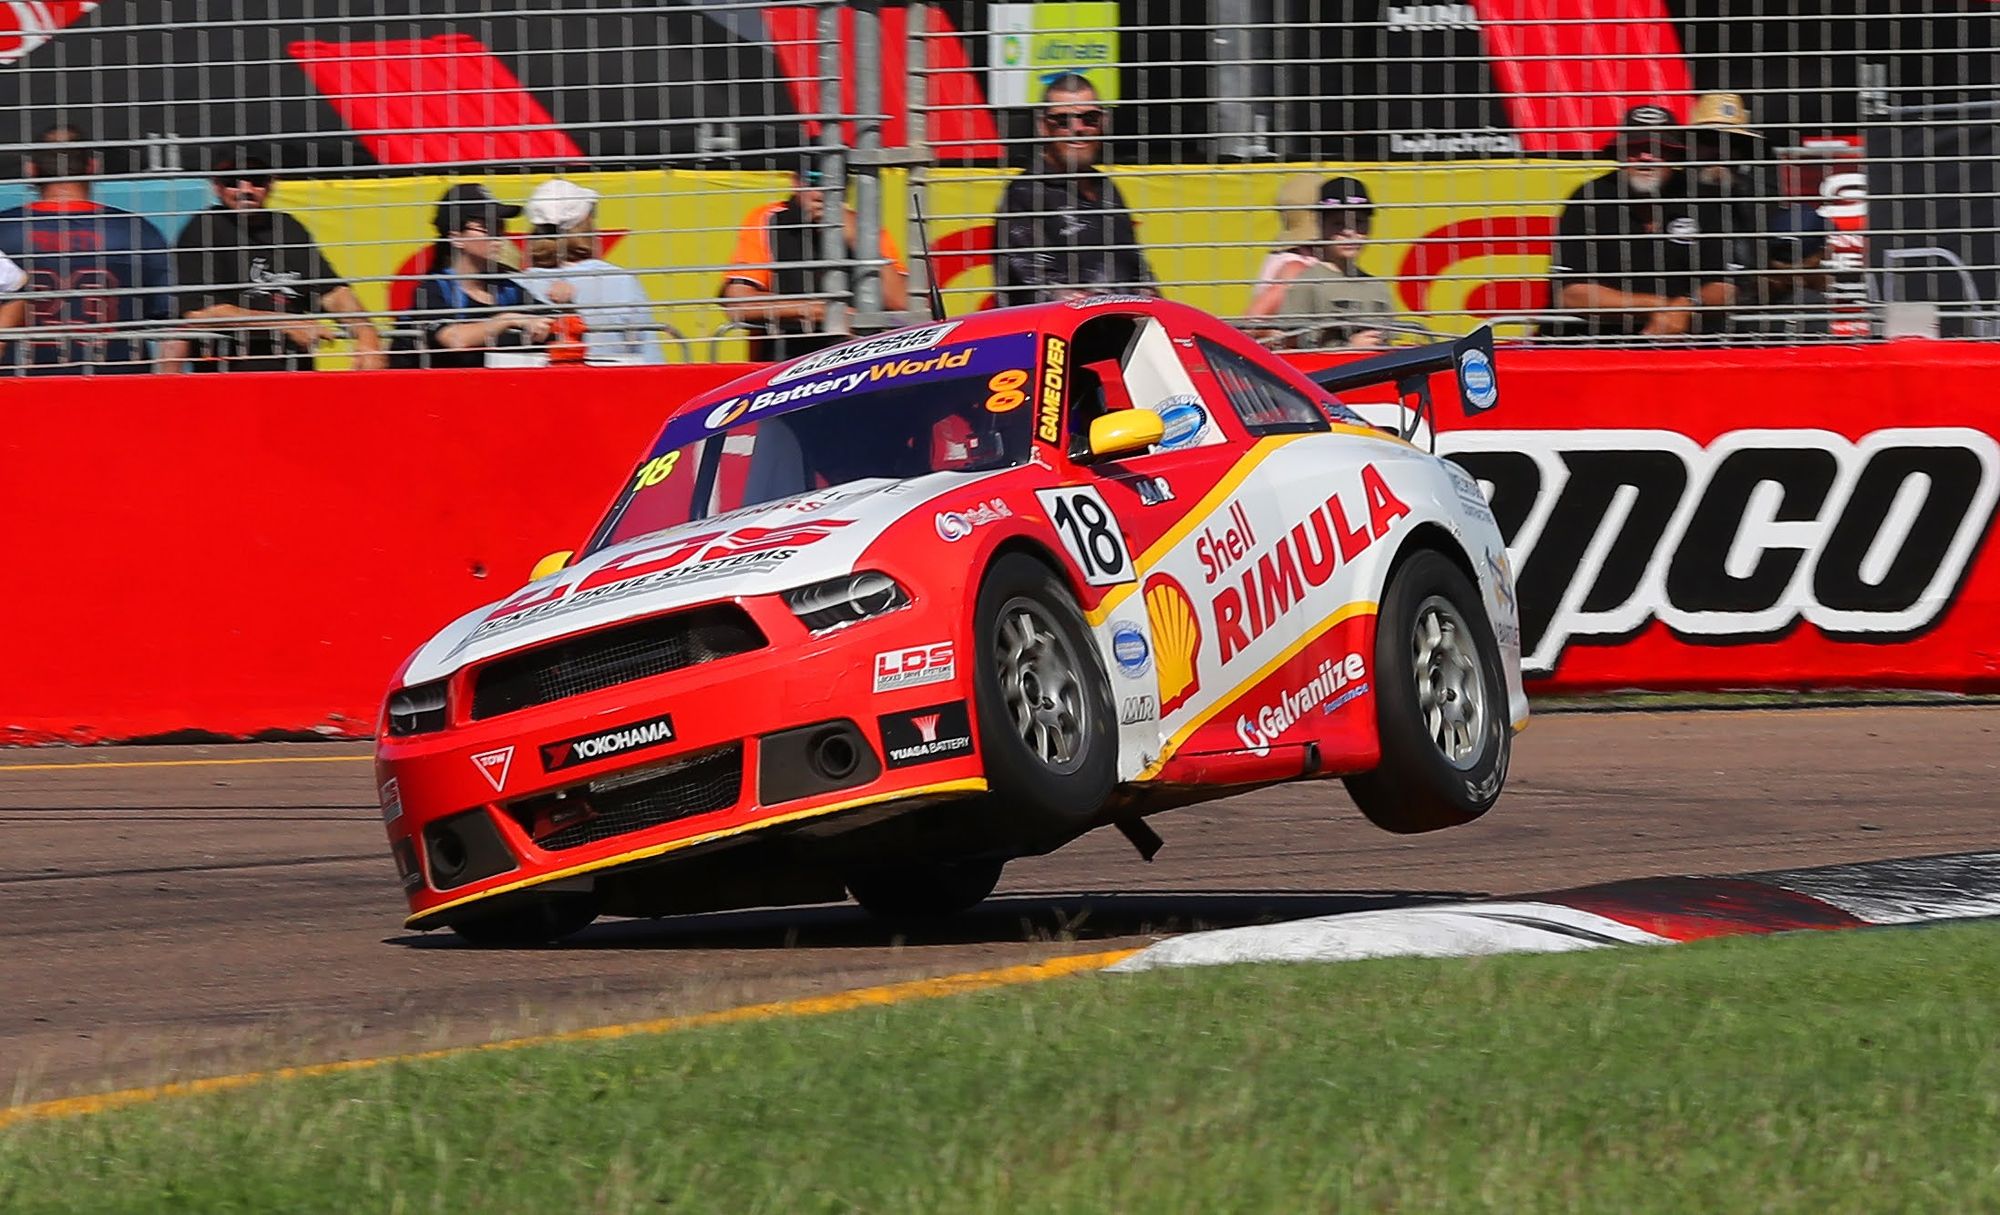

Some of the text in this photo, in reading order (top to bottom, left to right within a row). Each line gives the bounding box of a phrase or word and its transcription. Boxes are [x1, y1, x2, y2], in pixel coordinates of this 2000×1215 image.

[632, 450, 680, 492] 18
[1053, 494, 1123, 577] 18
[1196, 499, 1257, 584] Shell
[568, 574, 653, 603] DRIVE
[657, 549, 798, 581] SYSTEMS
[1212, 463, 1411, 666] RIMULA
[879, 645, 954, 676] LDS
[480, 752, 506, 767] TOW
[573, 721, 672, 759] YOKOHAMA
[889, 736, 970, 760] YUASA BATTERY
